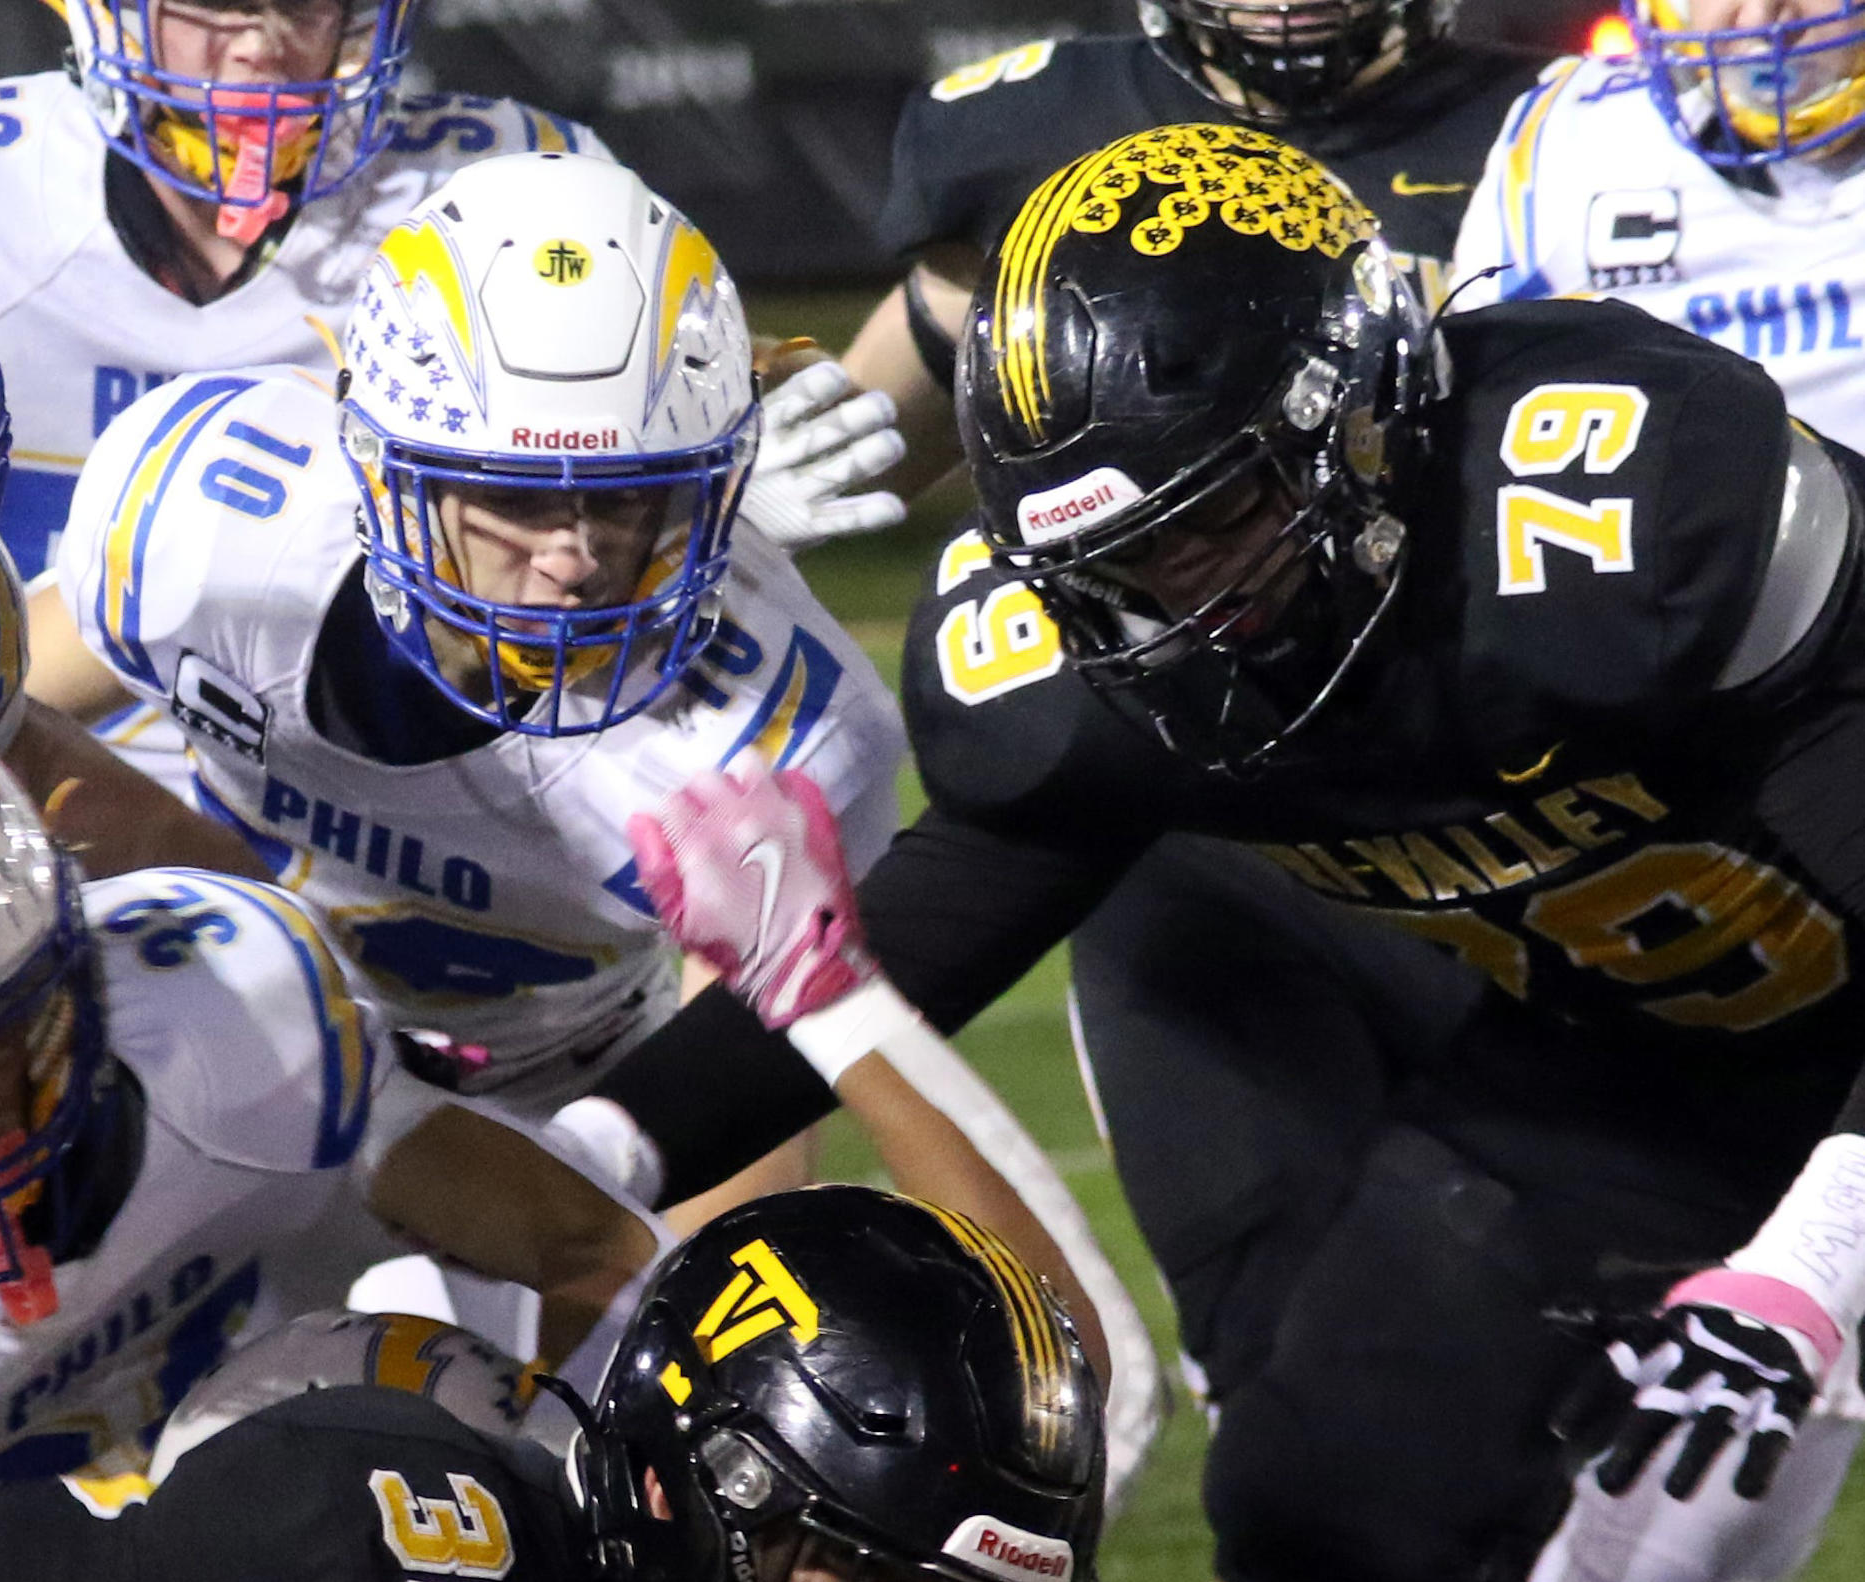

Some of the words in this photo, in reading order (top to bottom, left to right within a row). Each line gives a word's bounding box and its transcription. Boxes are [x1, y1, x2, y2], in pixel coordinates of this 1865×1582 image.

[197, 418, 316, 523] 10
[511, 427, 619, 451] Riddell
[1496, 383, 1649, 596] 79
[1027, 484, 1116, 531] Riddell
[261, 774, 491, 912] PHILO
[6, 1254, 215, 1433] PHILO
[977, 1529, 1070, 1578] Riddell
